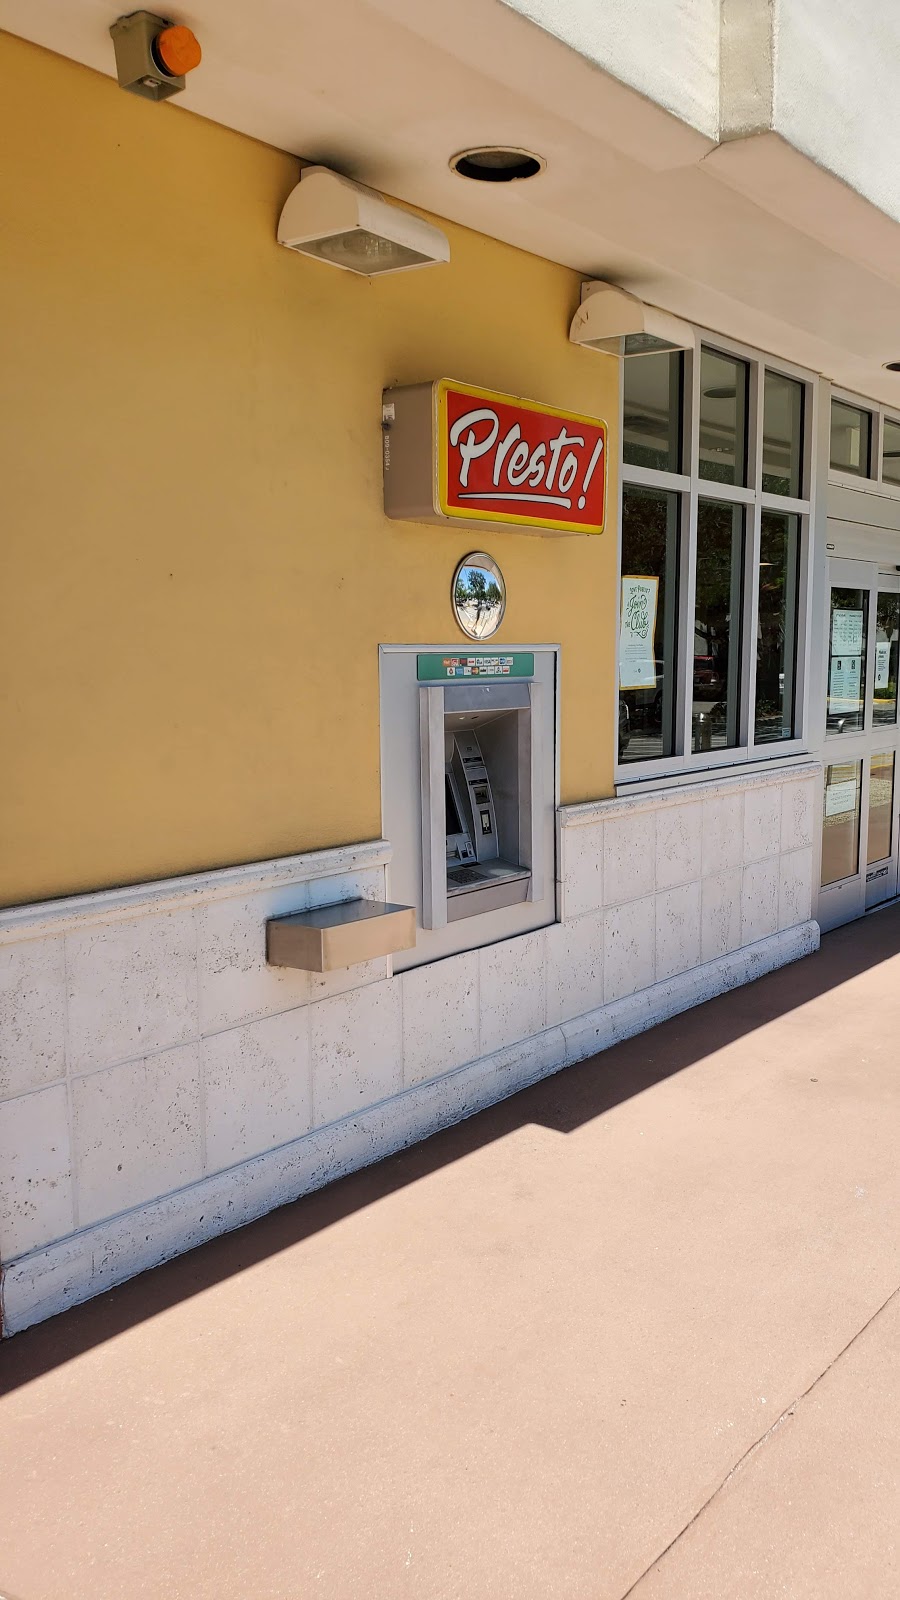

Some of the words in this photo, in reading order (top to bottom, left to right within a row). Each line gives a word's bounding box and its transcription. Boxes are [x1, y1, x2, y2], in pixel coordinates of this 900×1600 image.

[450, 408, 603, 510] Presto!
[627, 594, 647, 617] Join
[631, 610, 649, 631] Club
